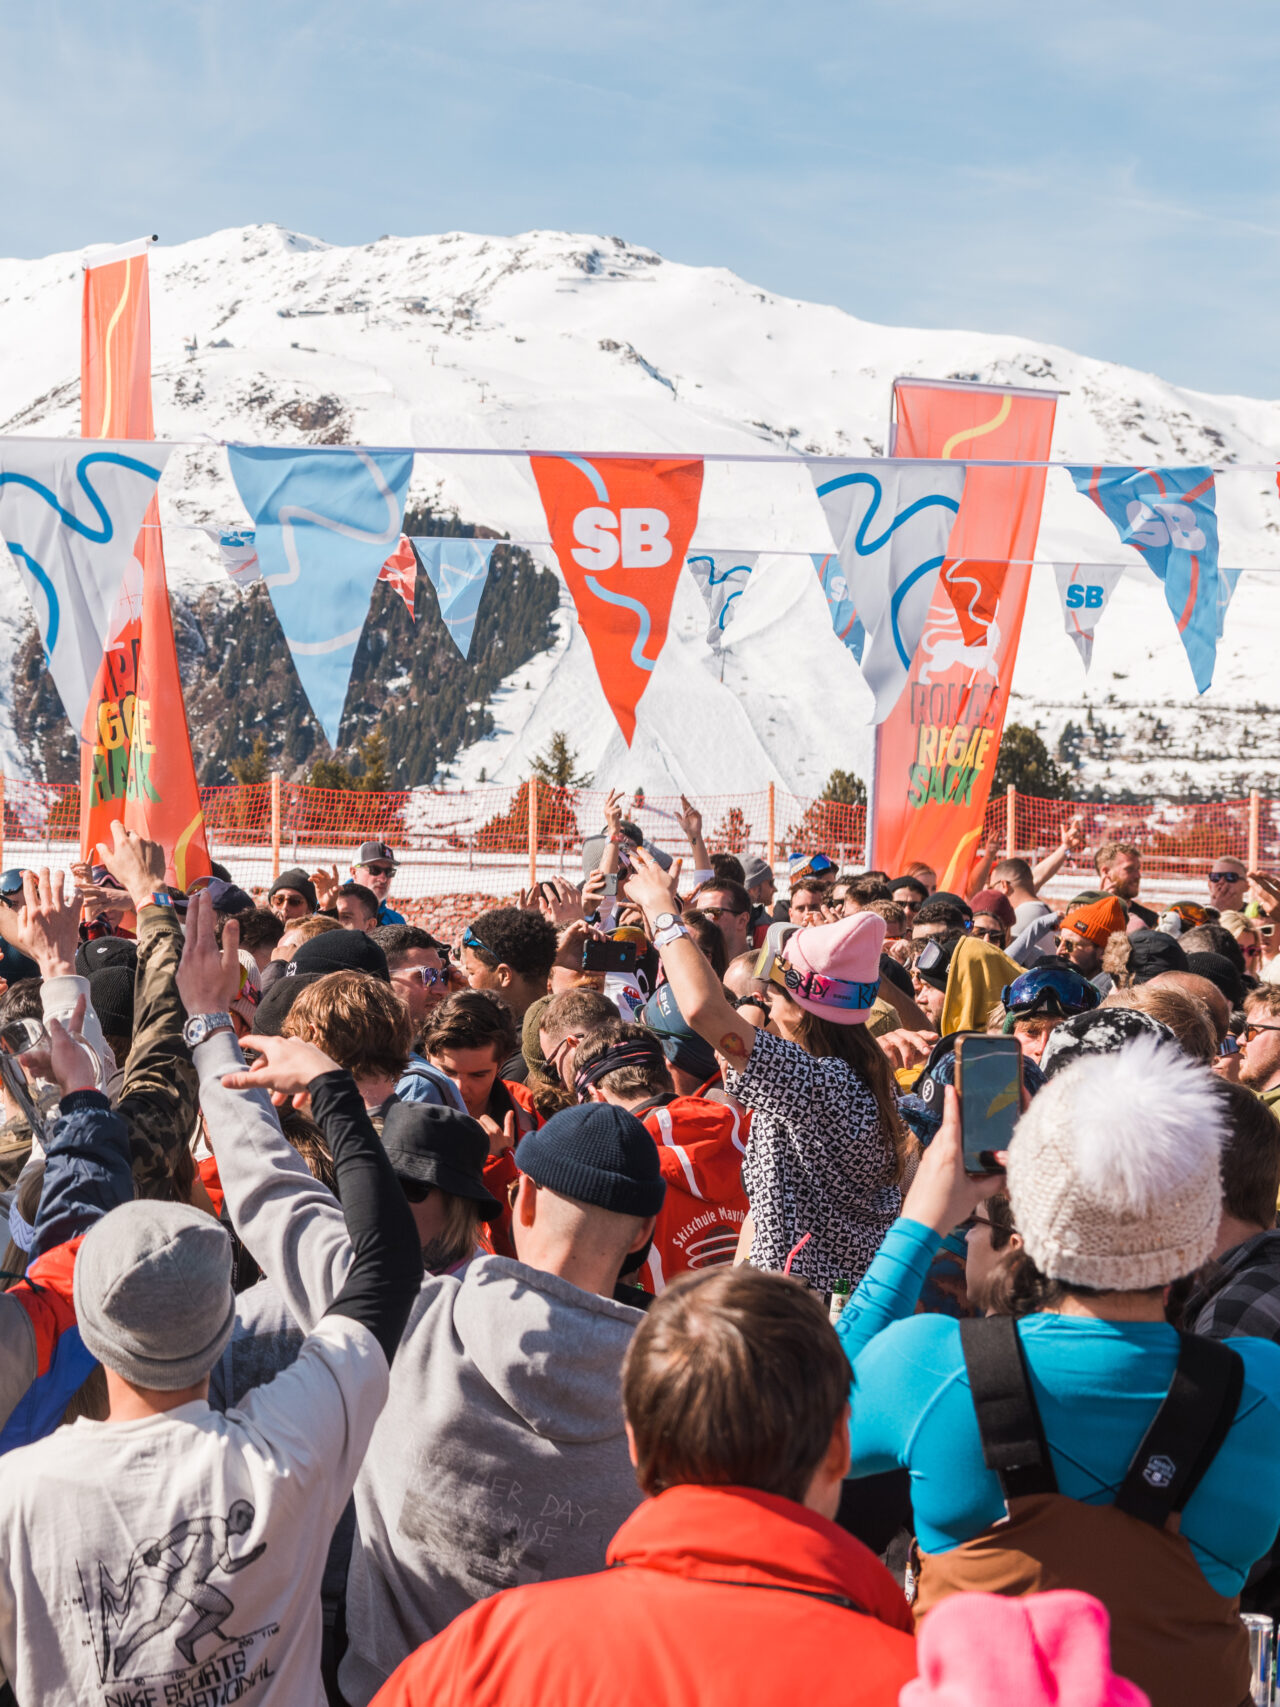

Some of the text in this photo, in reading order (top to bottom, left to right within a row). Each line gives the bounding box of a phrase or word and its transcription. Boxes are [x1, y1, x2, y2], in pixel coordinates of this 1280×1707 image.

[570, 506, 673, 571] SB
[1126, 500, 1207, 551] SB
[1066, 584, 1104, 608] SB
[660, 985, 672, 1016] LEKI
[672, 1206, 745, 1248] Skischule Mayrh
[539, 1493, 600, 1528] DAY
